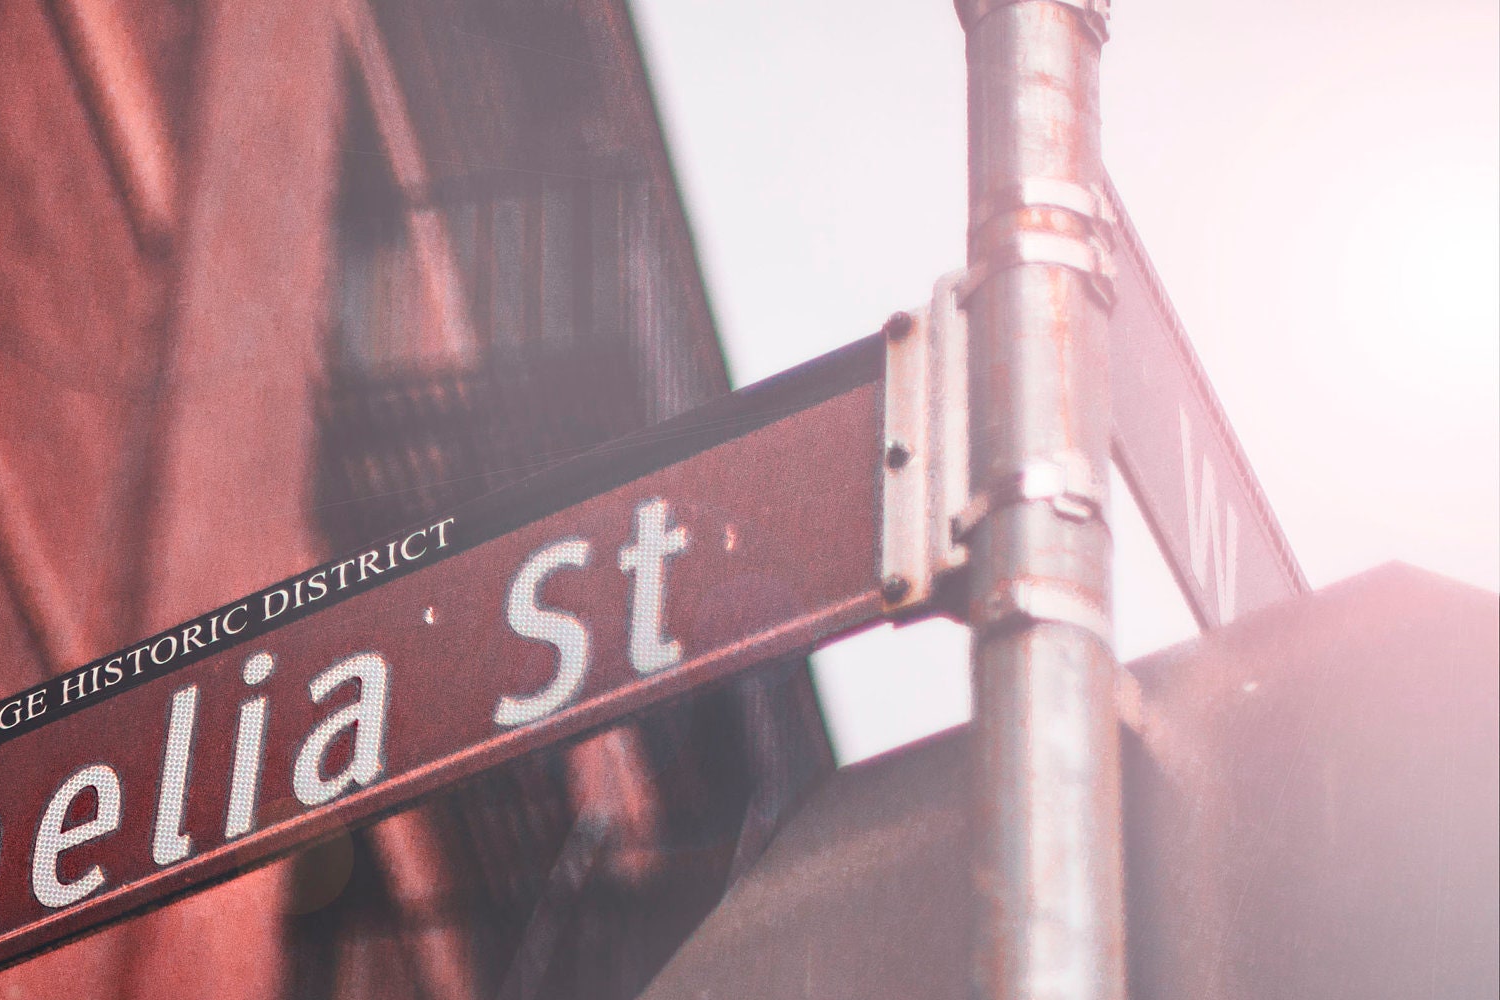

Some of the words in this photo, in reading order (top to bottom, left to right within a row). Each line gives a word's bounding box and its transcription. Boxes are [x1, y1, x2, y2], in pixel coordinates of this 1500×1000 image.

[60, 605, 248, 707] HISTORIC
[262, 517, 455, 623] DISTRICT
[493, 497, 686, 728] St
